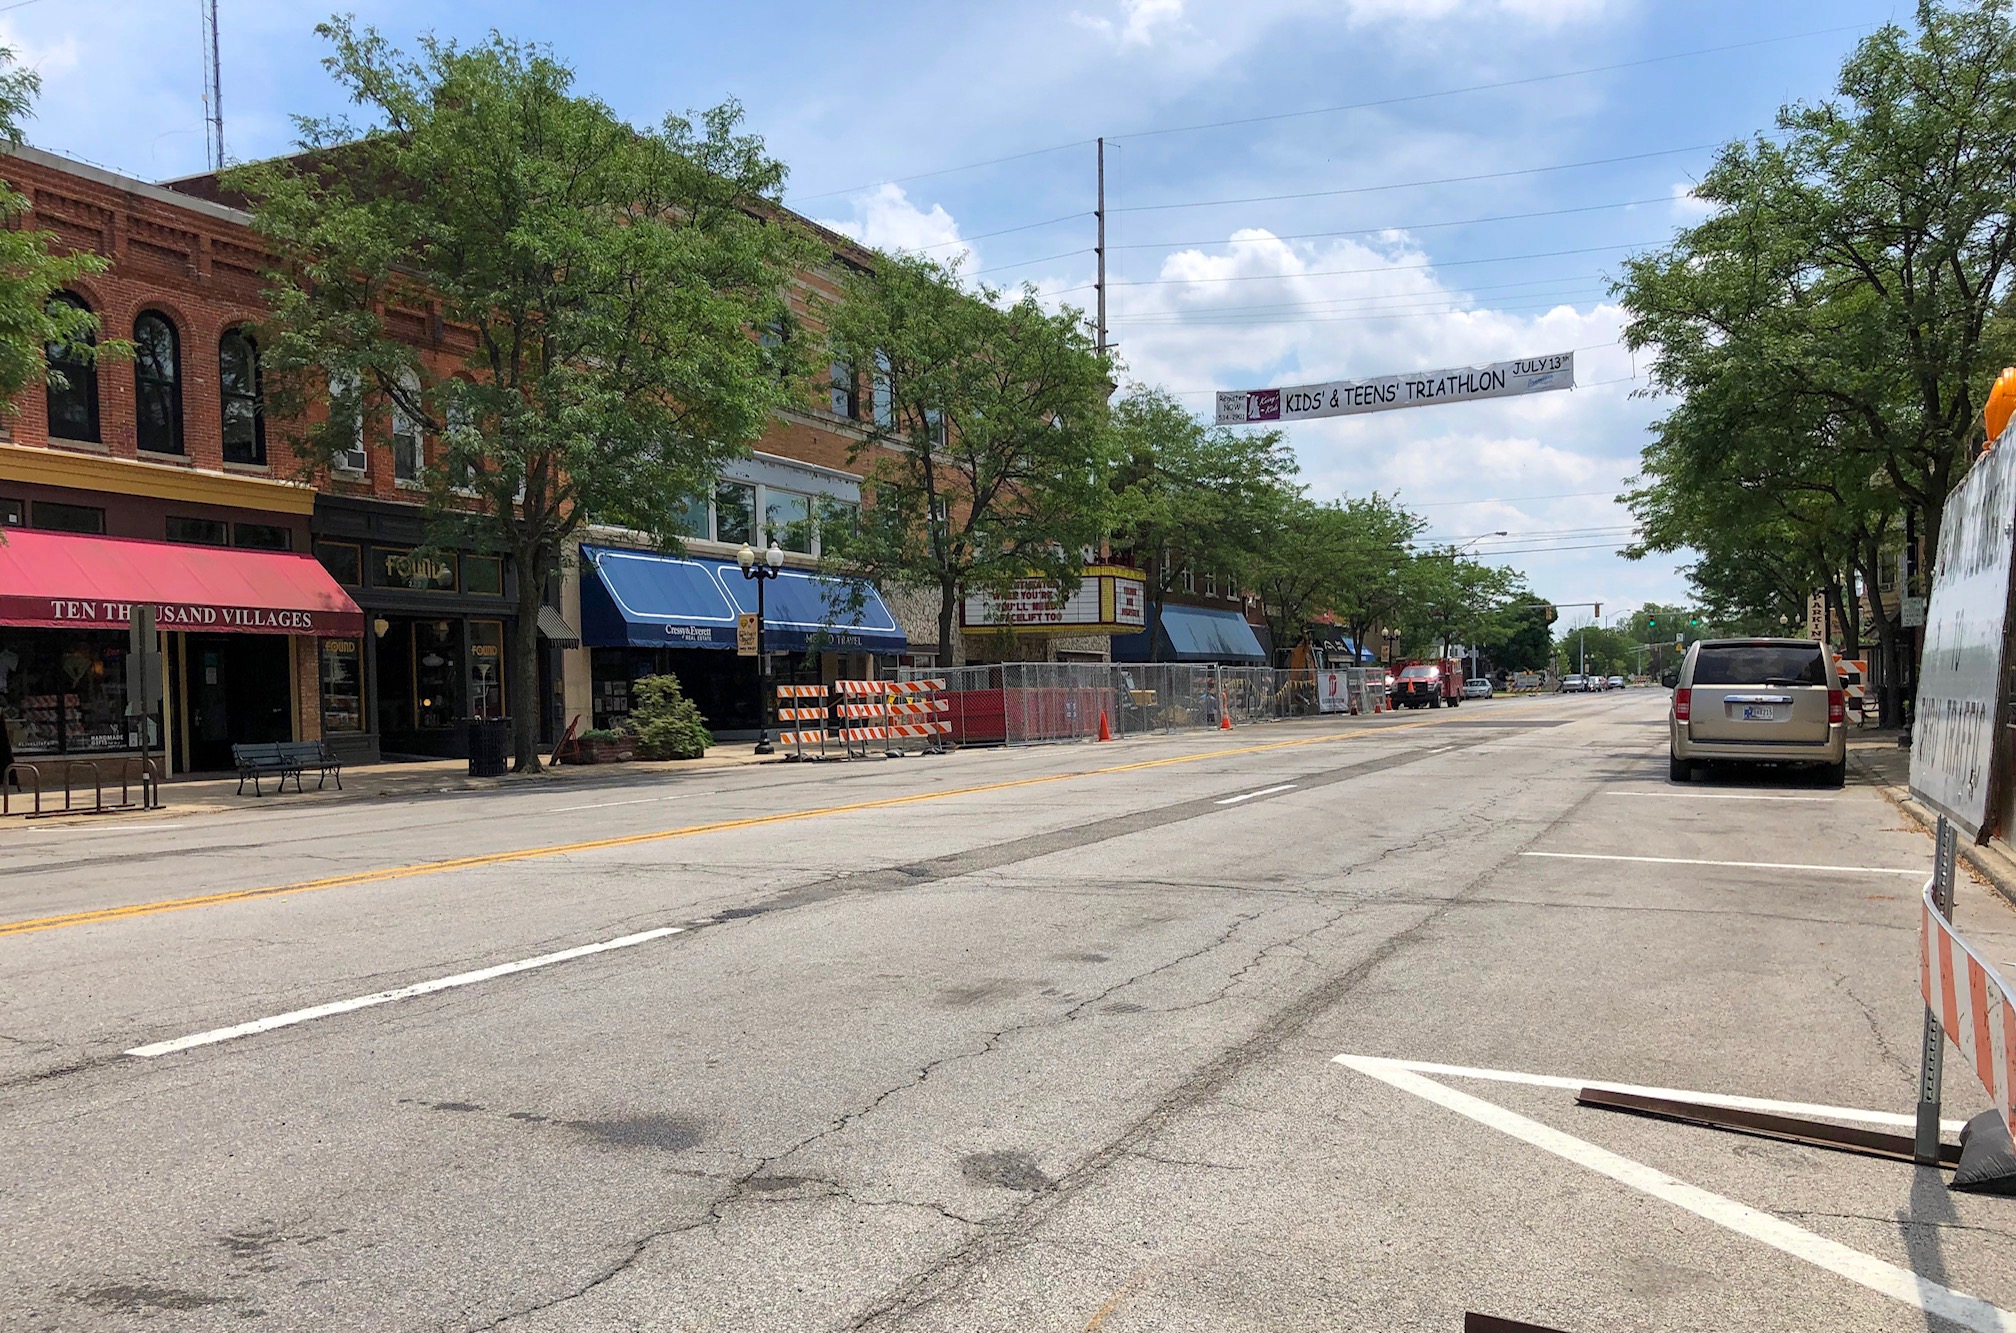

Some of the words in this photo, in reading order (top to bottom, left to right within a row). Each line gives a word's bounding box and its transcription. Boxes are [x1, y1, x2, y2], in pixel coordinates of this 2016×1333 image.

[1513, 359, 1547, 375] JULY
[1286, 391, 1325, 413] KIDS'
[1329, 389, 1339, 408] &
[1344, 382, 1399, 406] TEENS'
[1405, 369, 1505, 400] TRIATHLON
[1223, 404, 1241, 412] NOW
[385, 555, 443, 580] FOUND
[51, 601, 97, 619] TEN
[102, 602, 216, 623] THUSAND
[221, 608, 313, 628] VILLAGES
[1811, 591, 1823, 640] PARKIN
[324, 641, 356, 653] FOUND
[805, 633, 835, 645] MEO
[836, 635, 863, 646] TRAVEL
[471, 645, 498, 656] FOUND
